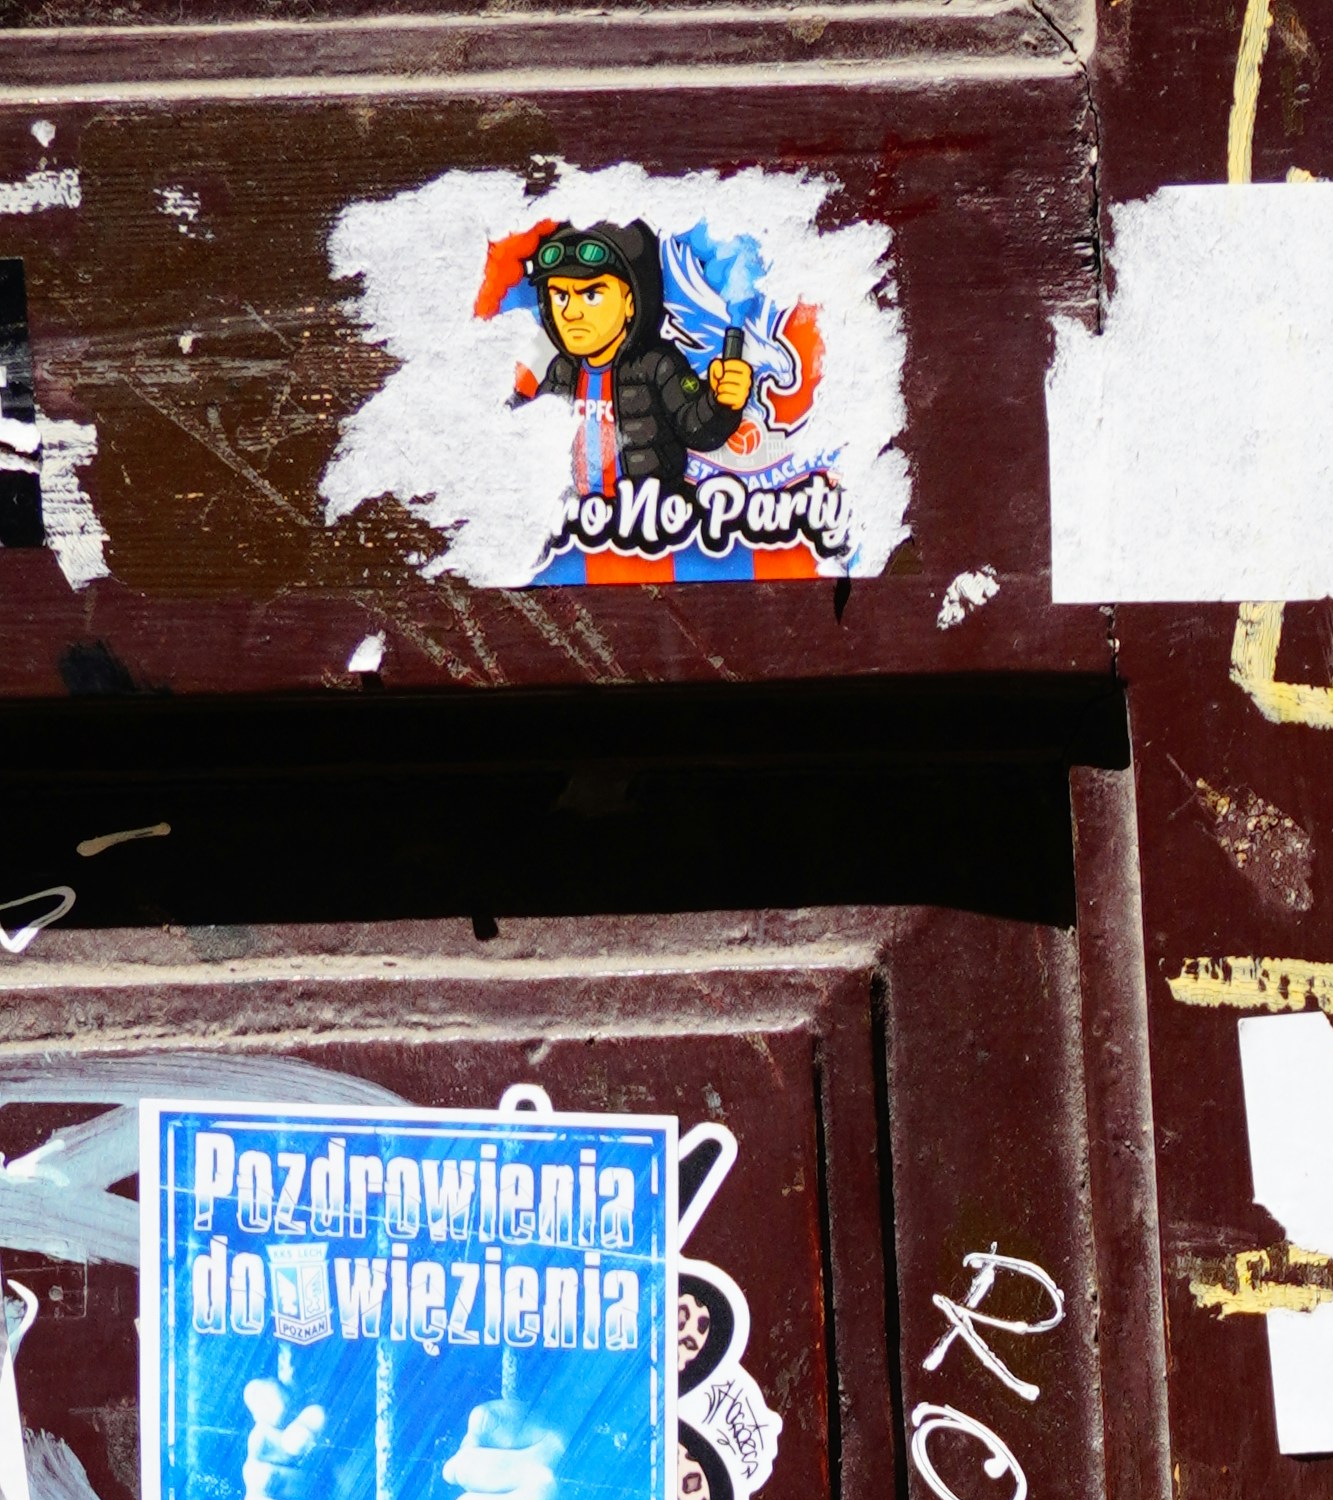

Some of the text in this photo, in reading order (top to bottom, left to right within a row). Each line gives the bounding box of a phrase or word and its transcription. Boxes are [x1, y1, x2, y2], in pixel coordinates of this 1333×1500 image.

[616, 476, 694, 543] No
[700, 475, 852, 550] Party
[194, 1130, 637, 1249] Pozdrowienia
[191, 1235, 640, 1356] do więzienia
